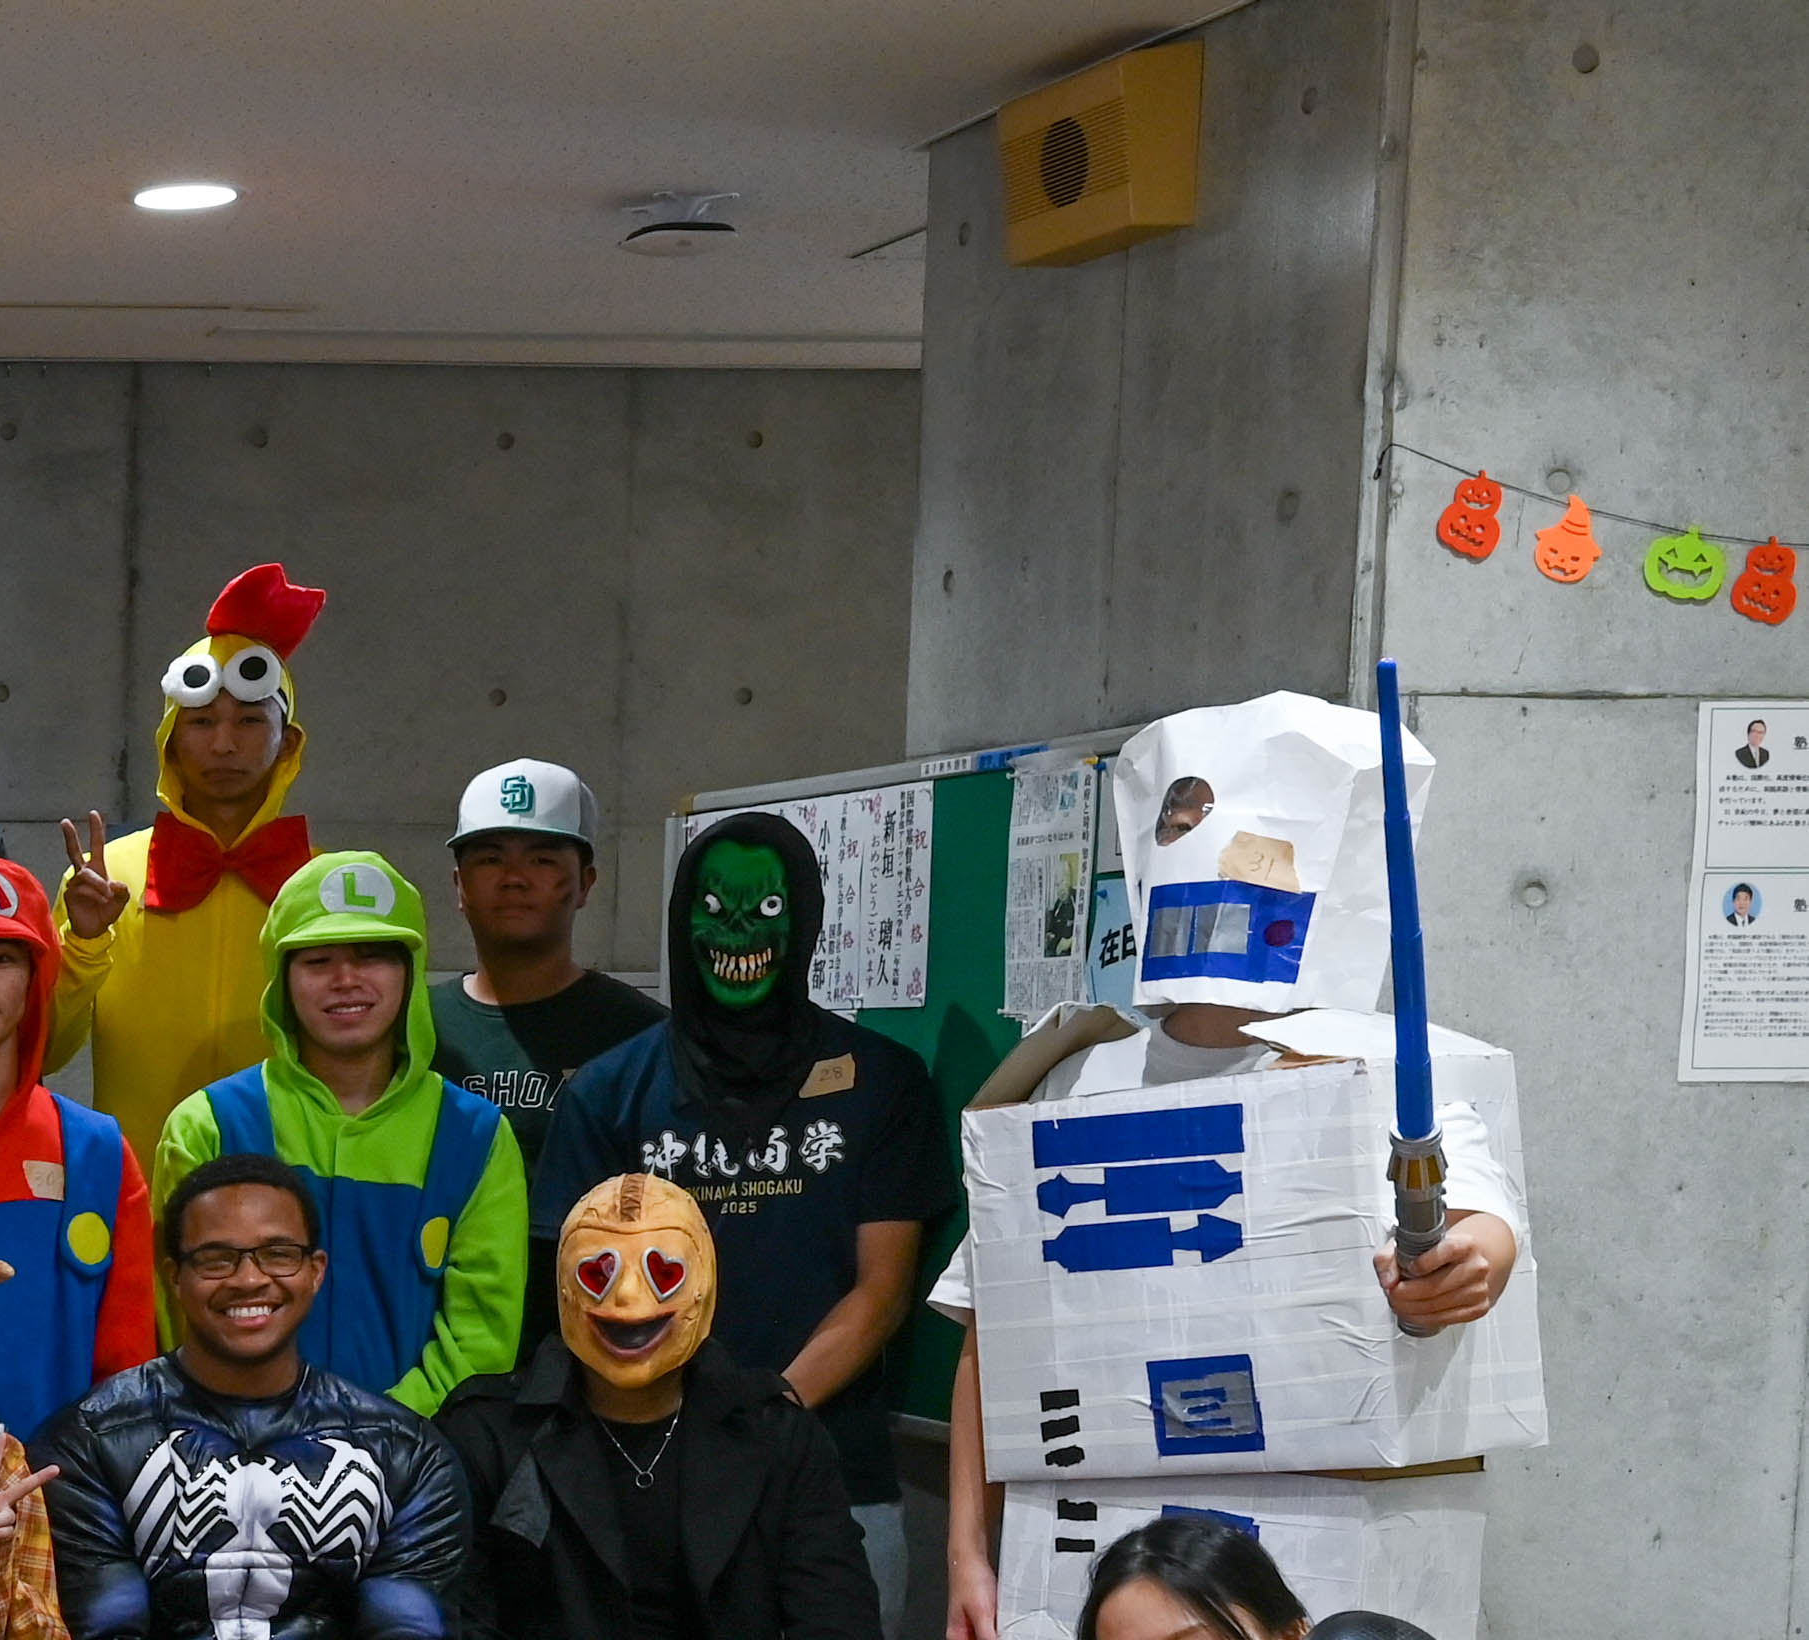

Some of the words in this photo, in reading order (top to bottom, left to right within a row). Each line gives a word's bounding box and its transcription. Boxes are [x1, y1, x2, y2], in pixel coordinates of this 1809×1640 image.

[501, 775, 534, 815] SD
[342, 872, 376, 909] L
[818, 1066, 845, 1083] 28
[462, 1070, 566, 1112] SHO
[741, 1178, 803, 1198] SHOGAKU
[720, 1200, 758, 1215] 2025
